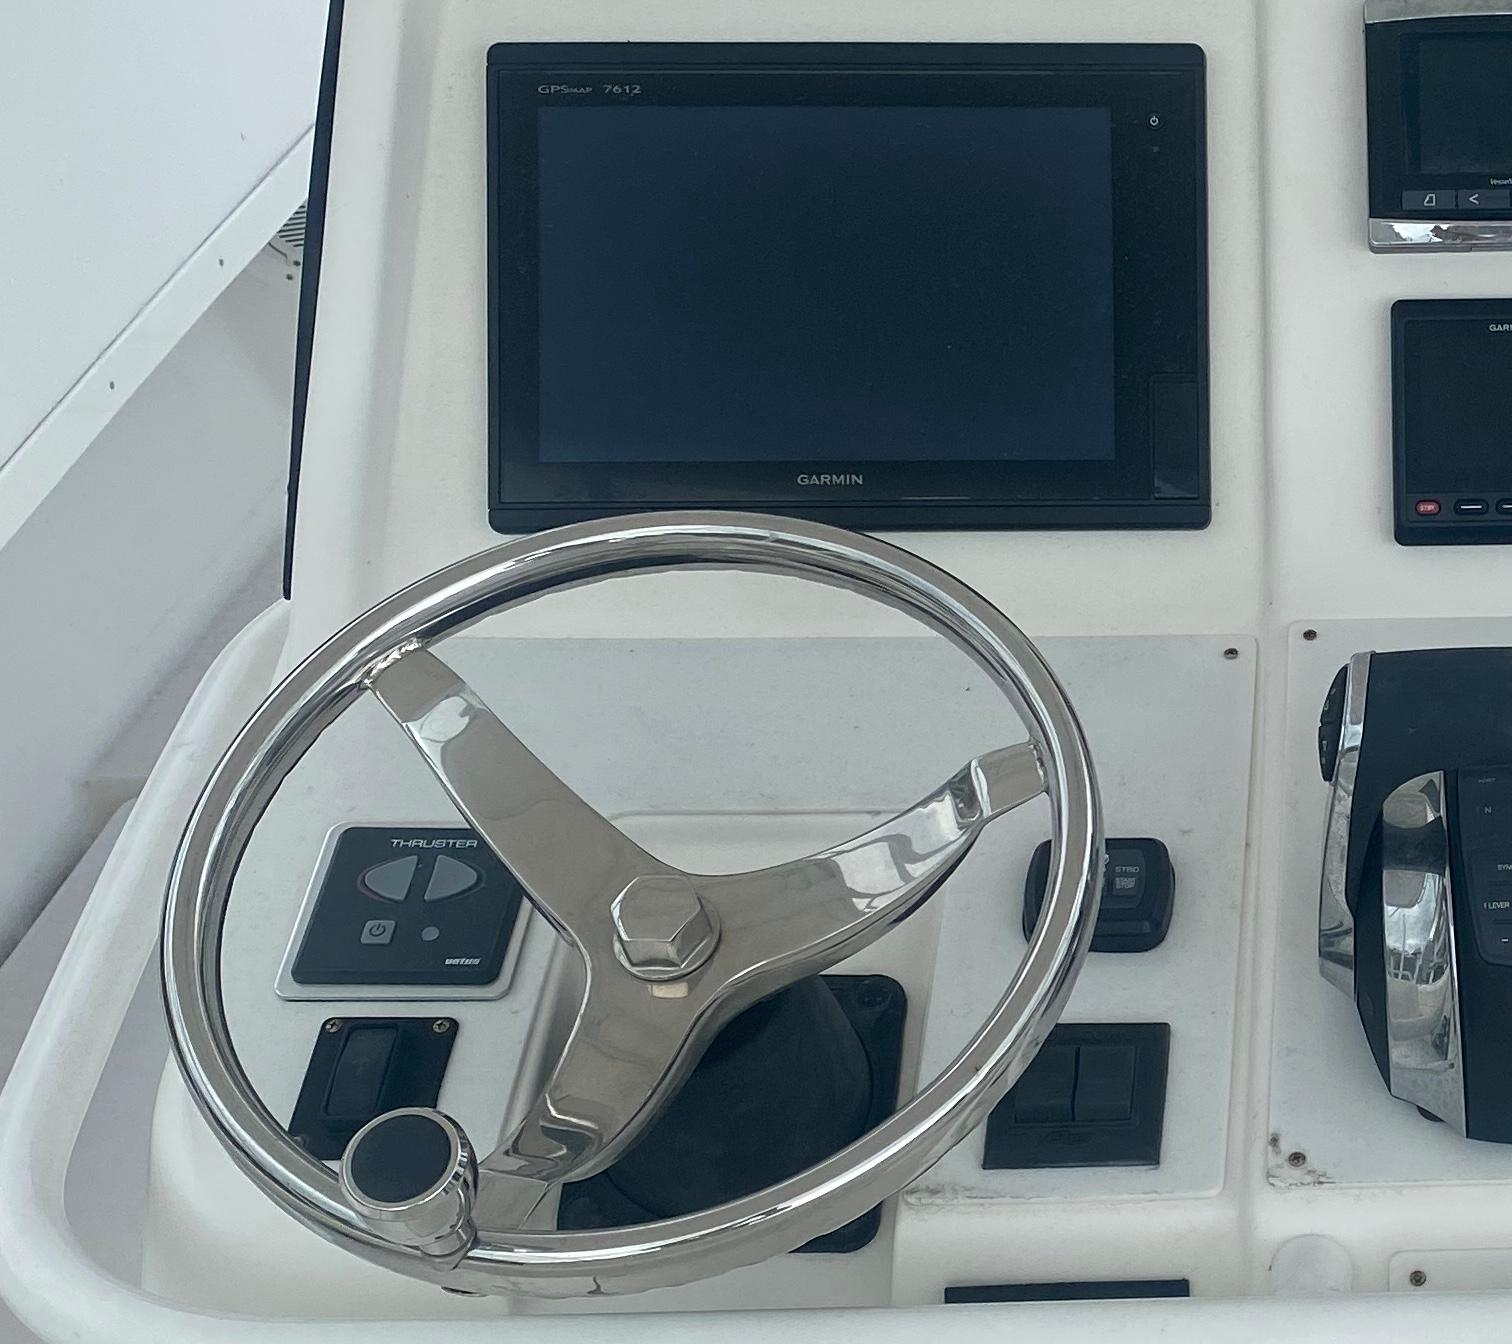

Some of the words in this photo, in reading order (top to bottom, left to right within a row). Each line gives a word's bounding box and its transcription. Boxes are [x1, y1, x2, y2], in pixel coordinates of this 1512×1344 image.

[602, 84, 642, 95] 7612
[797, 474, 864, 485] GARMIN
[391, 839, 478, 849] THRUSTER
